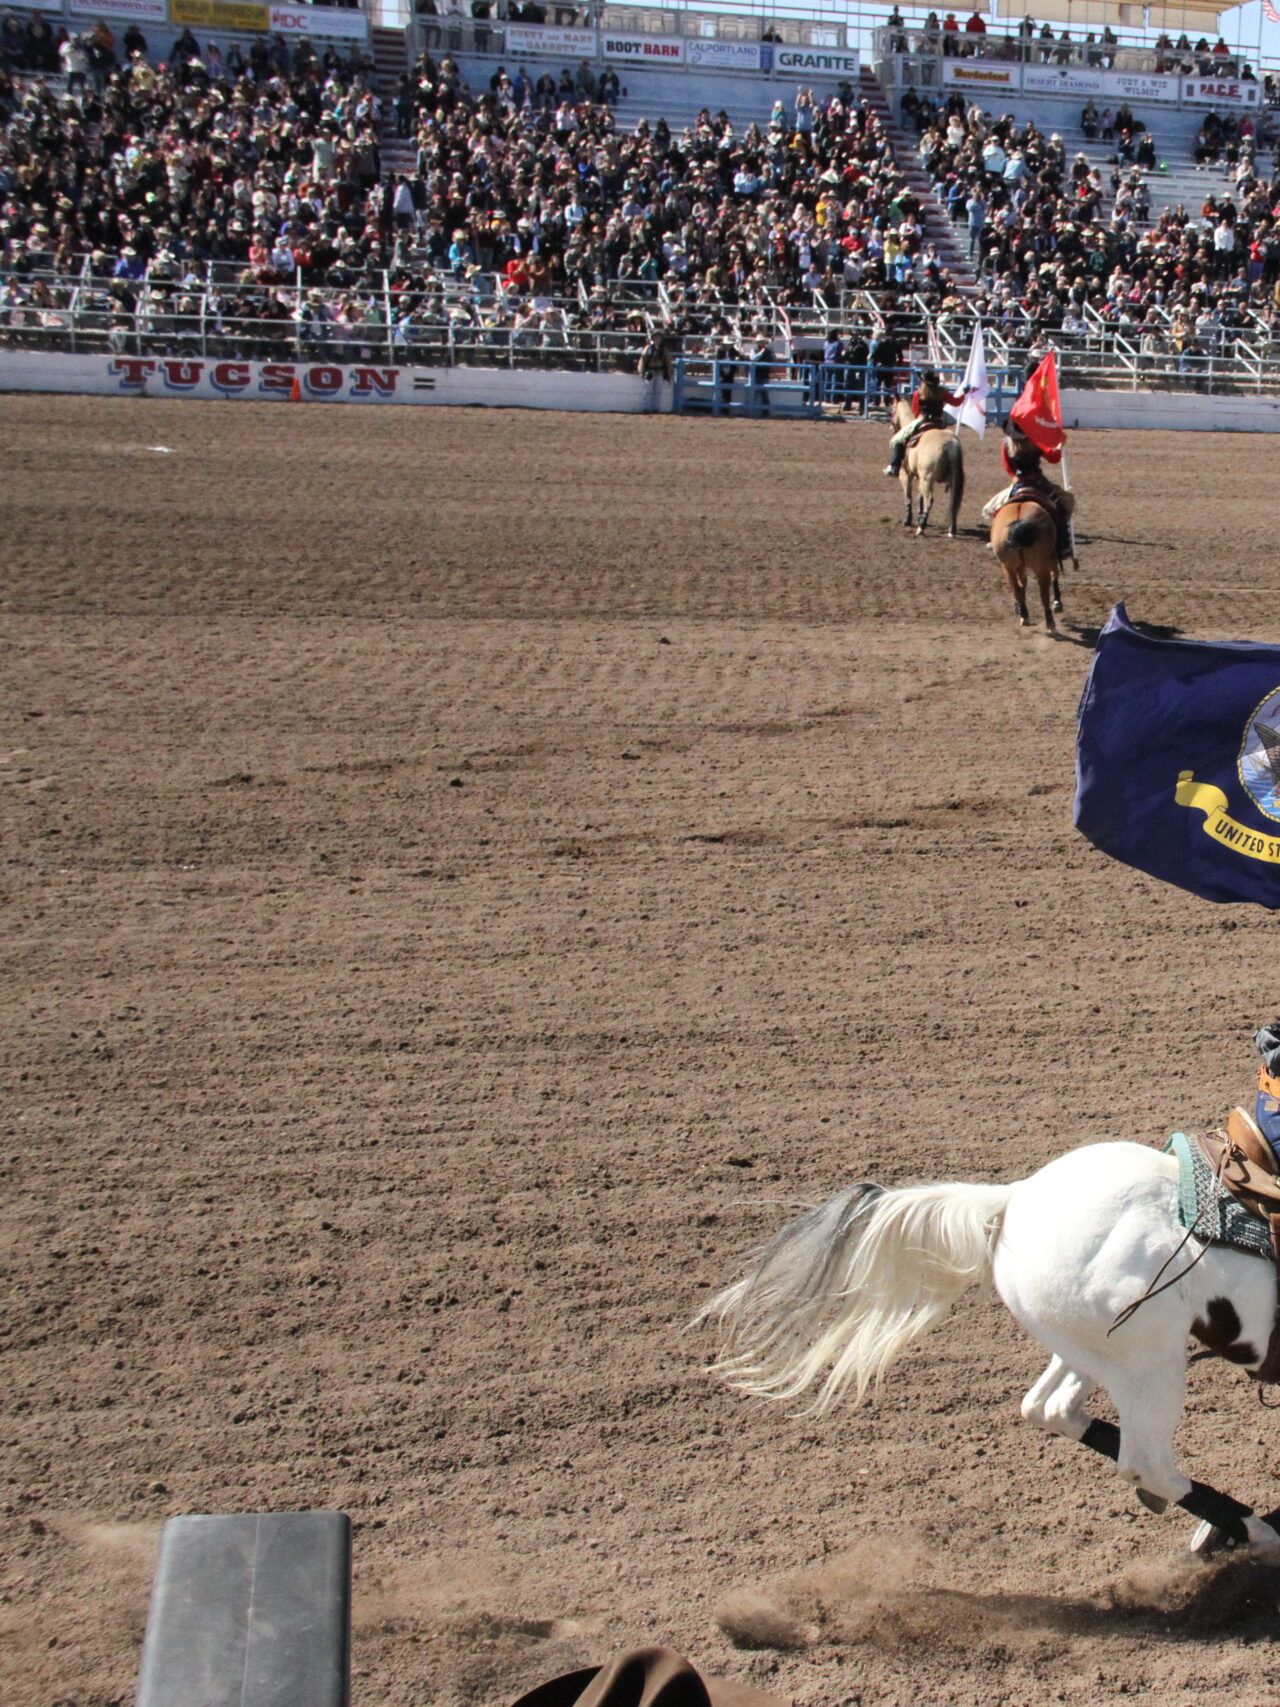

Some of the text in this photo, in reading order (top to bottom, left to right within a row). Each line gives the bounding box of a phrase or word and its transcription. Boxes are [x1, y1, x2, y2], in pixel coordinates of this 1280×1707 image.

[606, 41, 680, 57] BOOT BARN
[688, 42, 758, 56] CALPORTLAND
[779, 52, 855, 71] GRANITE
[1026, 77, 1100, 89] DESERT DIAMOND
[110, 359, 400, 395] TUCSON
[1215, 819, 1264, 853] UNITED
